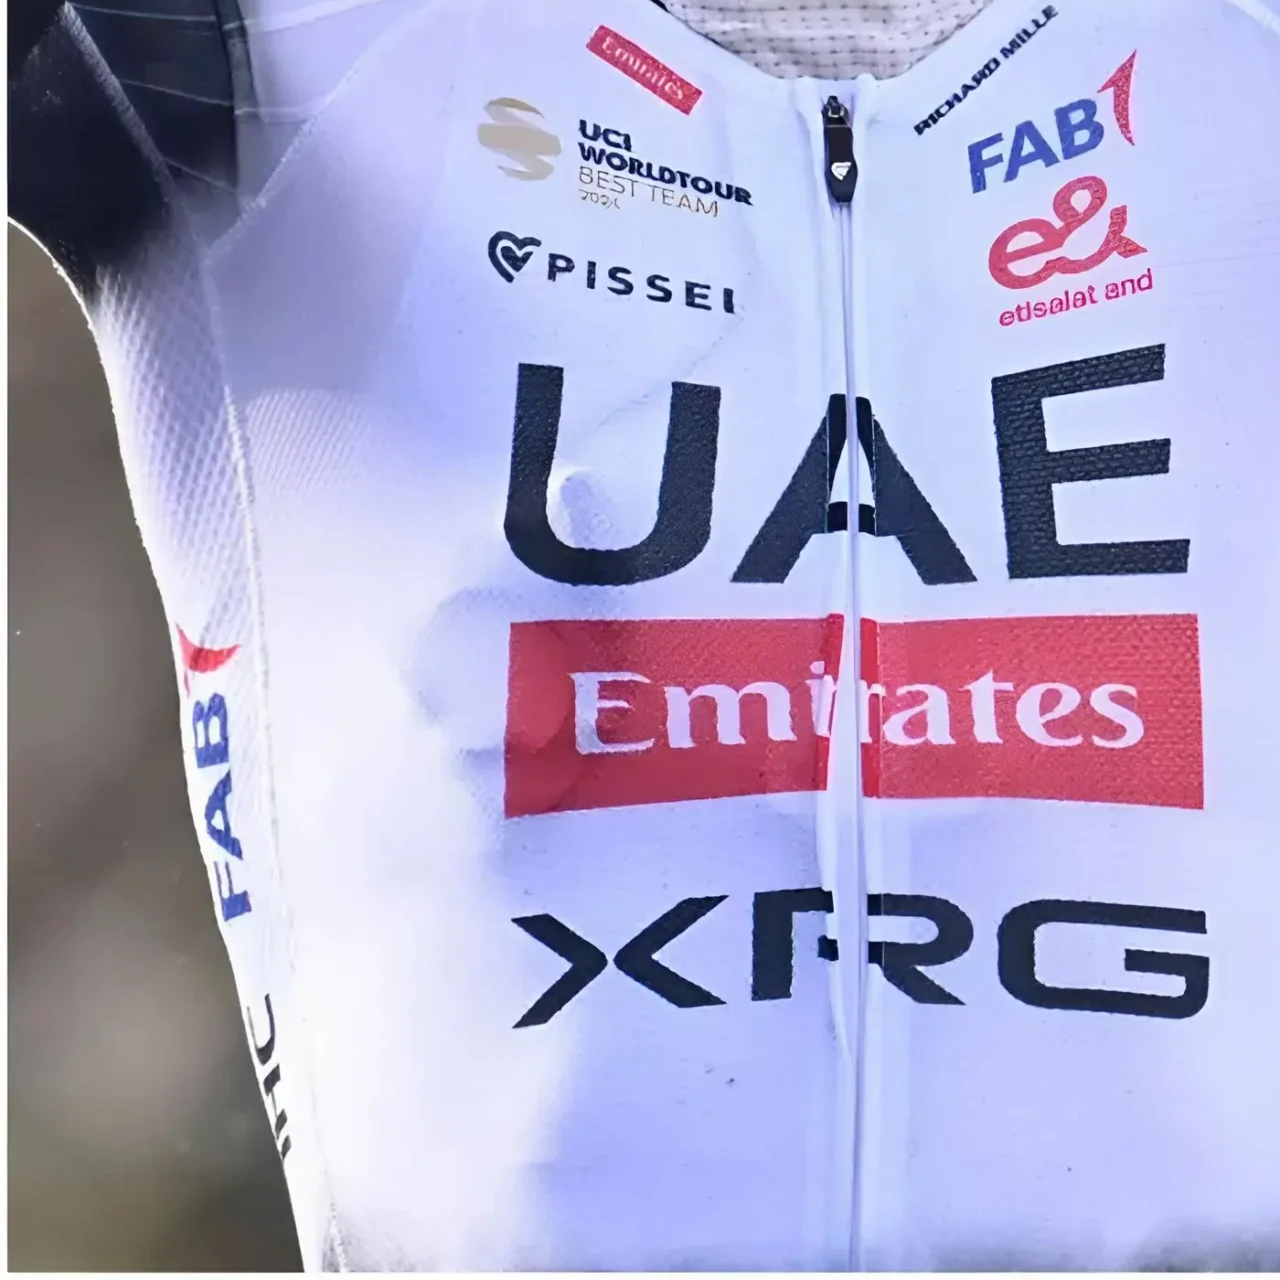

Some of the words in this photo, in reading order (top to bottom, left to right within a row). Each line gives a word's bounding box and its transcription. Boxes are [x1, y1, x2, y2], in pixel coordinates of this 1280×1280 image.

[913, 57, 1001, 136] RICHARD
[1000, 5, 1060, 60] MILLE
[578, 119, 633, 153] UCI
[577, 142, 754, 207] WORLDTOUR
[579, 166, 639, 198] BEST
[649, 183, 719, 218] TEAM
[546, 252, 736, 315] PISSEI
[1105, 268, 1154, 301] and
[503, 344, 1191, 587] UAE
[568, 660, 1147, 756] Emirates
[509, 886, 1211, 1029] XRG
